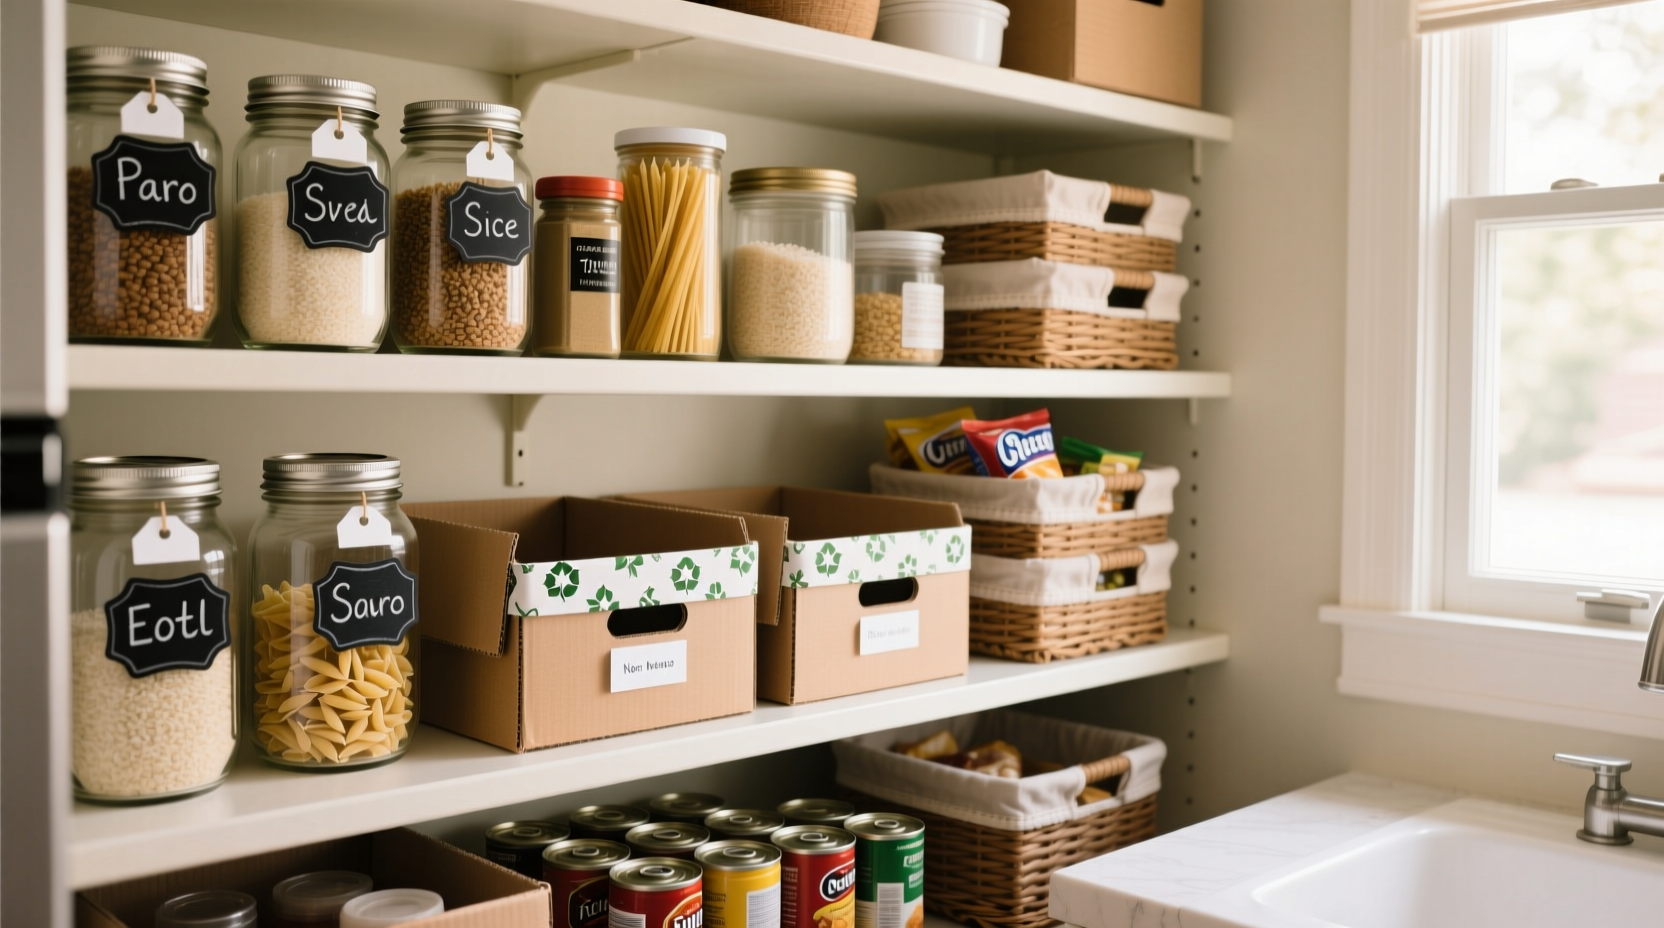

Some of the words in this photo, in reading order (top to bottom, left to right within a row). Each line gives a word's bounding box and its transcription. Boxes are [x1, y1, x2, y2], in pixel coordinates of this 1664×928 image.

[117, 156, 197, 205] Paro
[463, 201, 519, 239] Sice
[128, 598, 214, 647] Eotl
